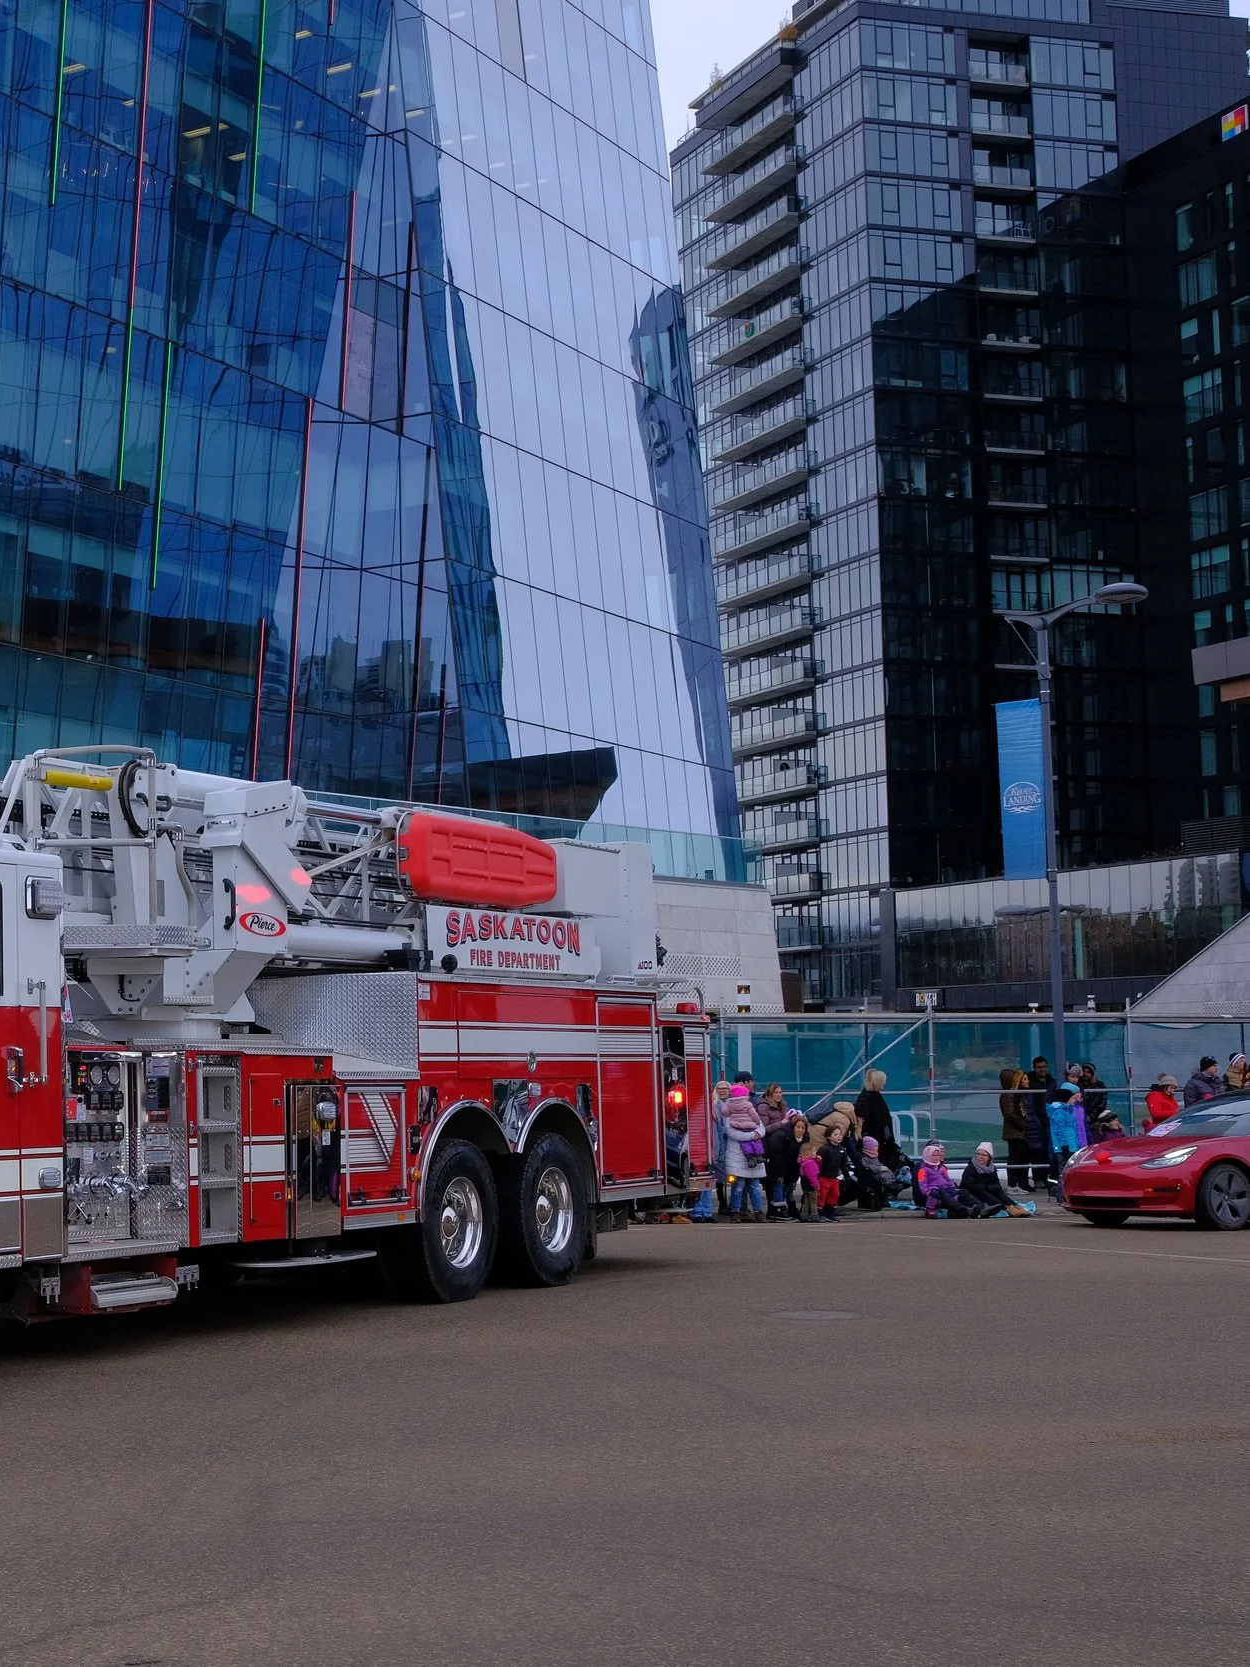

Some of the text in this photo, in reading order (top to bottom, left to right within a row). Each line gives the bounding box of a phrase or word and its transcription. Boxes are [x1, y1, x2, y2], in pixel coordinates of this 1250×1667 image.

[1003, 792, 1041, 807] LANDING
[249, 914, 276, 932] Pierce
[446, 910, 581, 956] SASKATOON
[469, 948, 561, 971] FIRE DEPARTMENT
